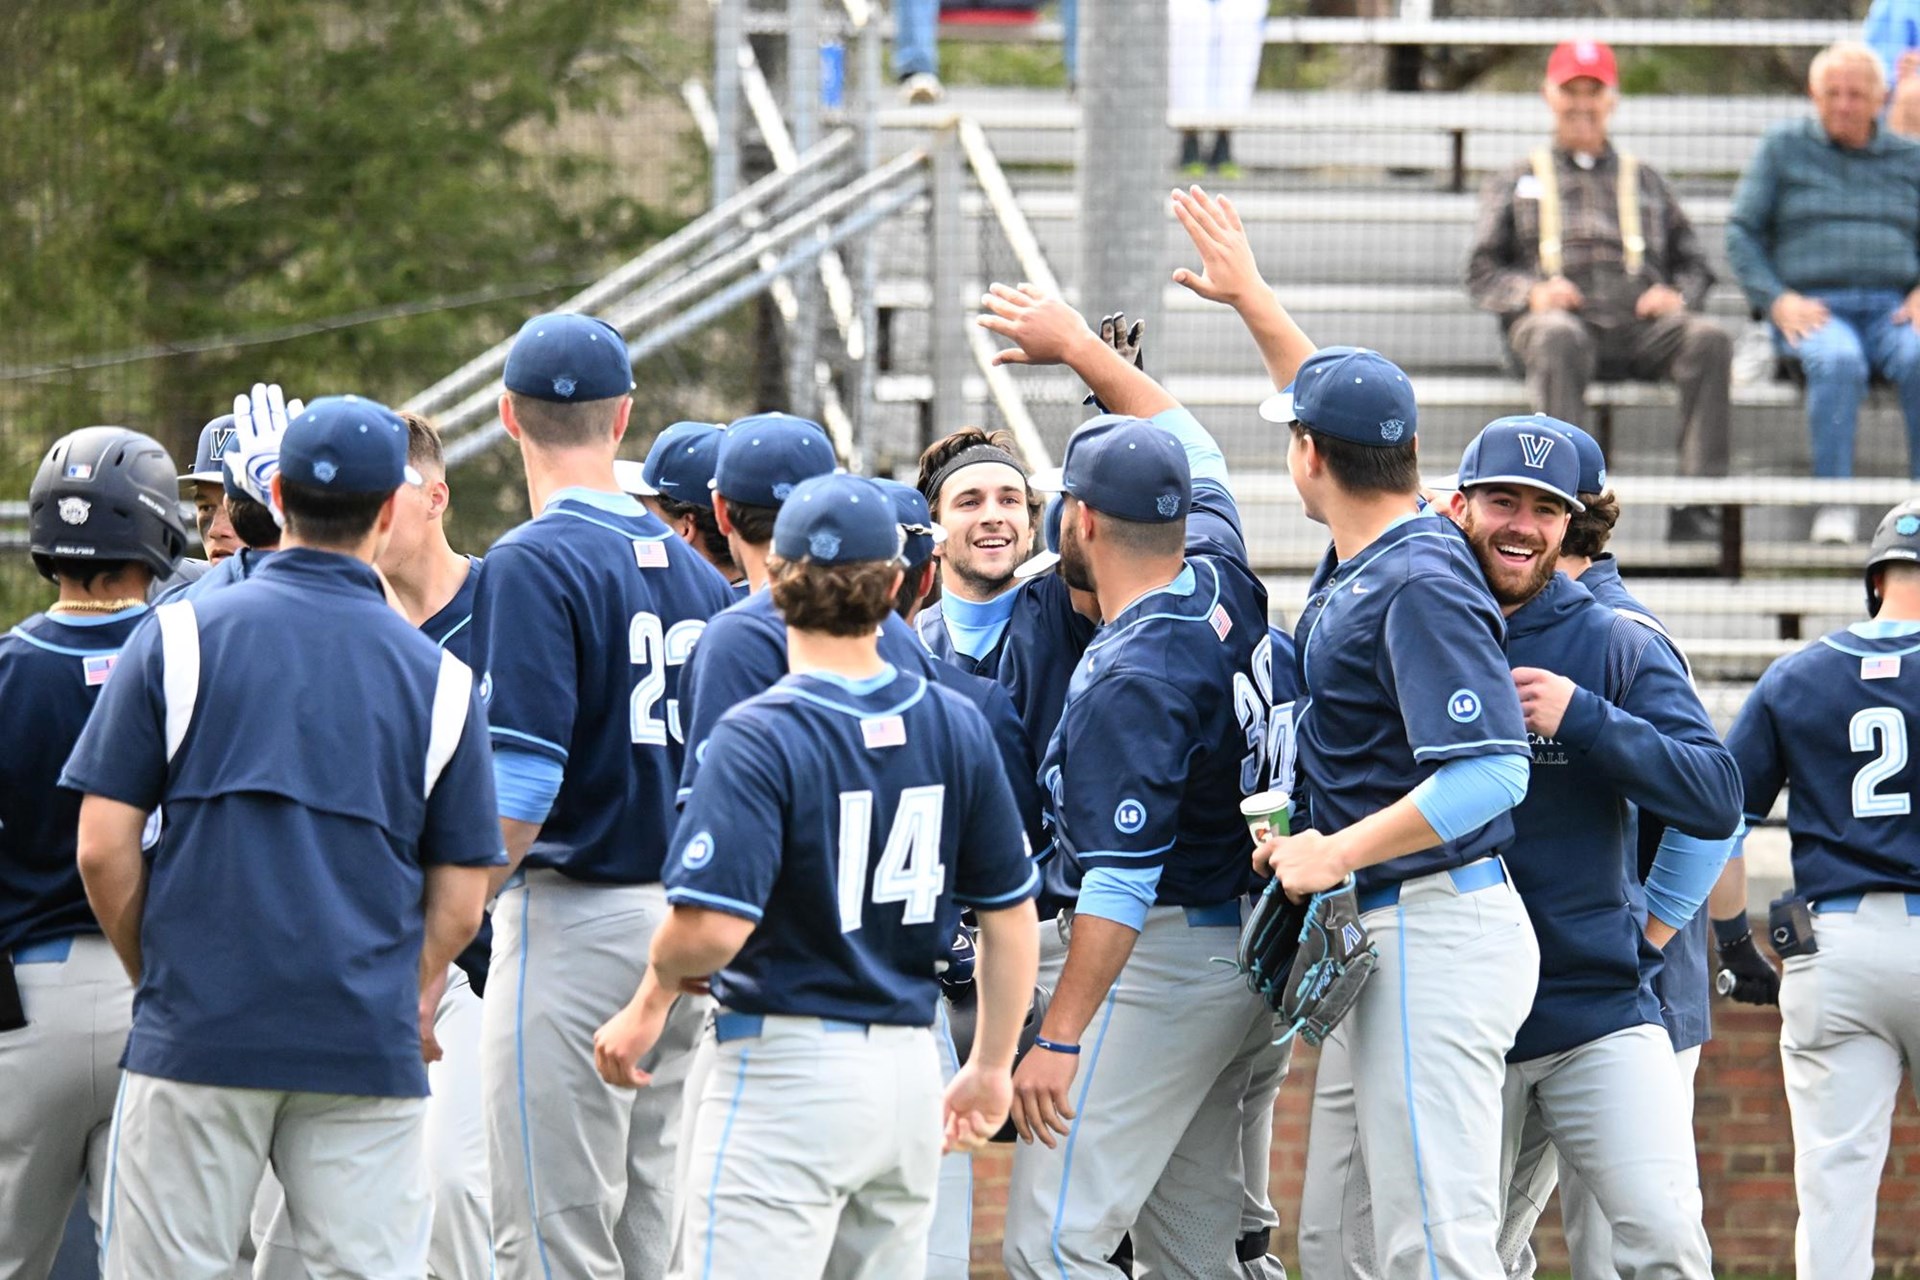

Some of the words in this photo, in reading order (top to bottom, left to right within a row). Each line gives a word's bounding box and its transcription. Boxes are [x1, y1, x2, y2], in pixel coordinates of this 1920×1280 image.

[209, 428, 238, 461] V
[1518, 433, 1554, 469] V
[1454, 698, 1474, 714] LS
[1531, 751, 1569, 764] ALL
[1849, 706, 1911, 818] 2
[1120, 809, 1139, 823] LS
[838, 784, 945, 934] 14
